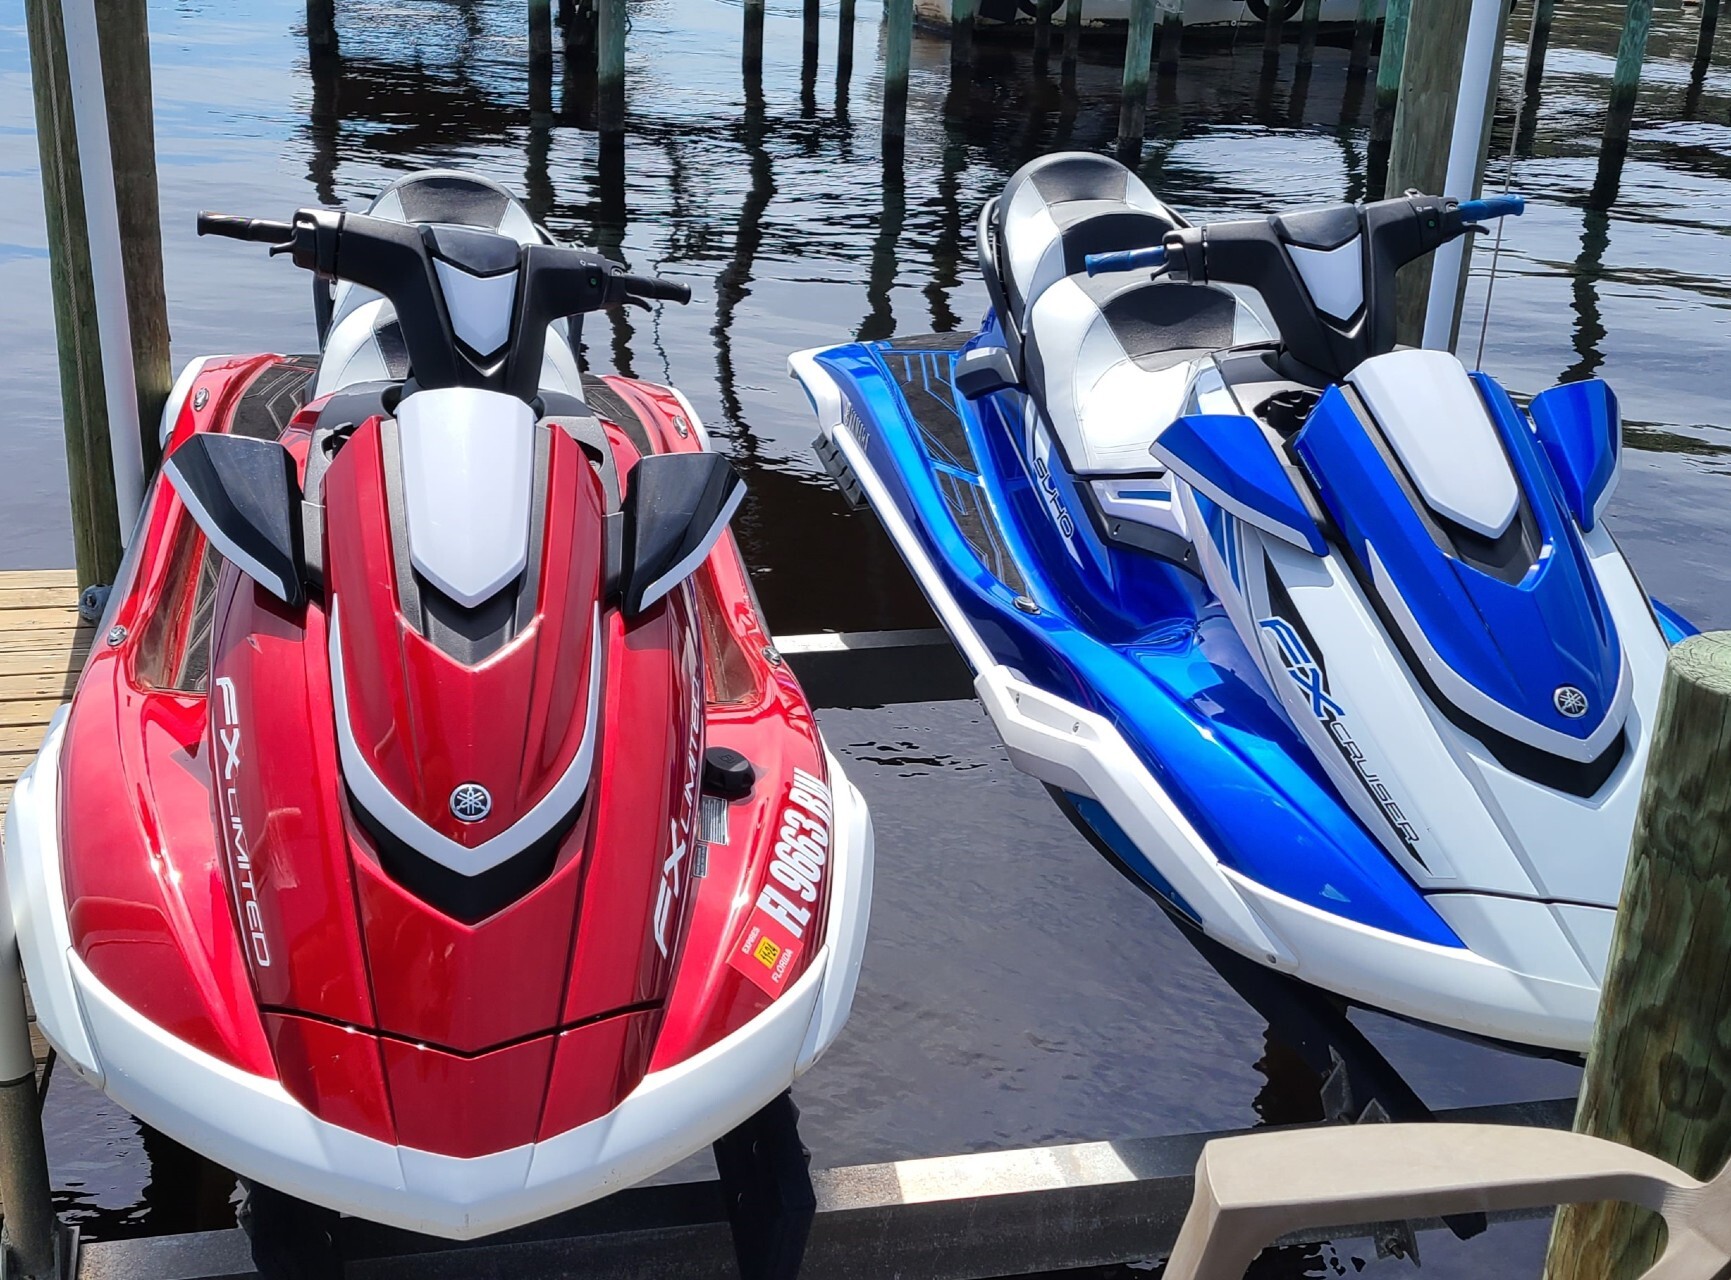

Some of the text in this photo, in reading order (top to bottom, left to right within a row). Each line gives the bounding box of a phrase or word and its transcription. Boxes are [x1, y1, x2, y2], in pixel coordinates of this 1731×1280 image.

[1258, 616, 1420, 842] FX CRUISER
[216, 677, 270, 966] FX LIMITED
[654, 817, 686, 959] FX
[681, 675, 701, 834] LIMITED
[769, 808, 828, 902] 9663
[756, 883, 811, 938] FL
[771, 949, 793, 983] FLORIDA
